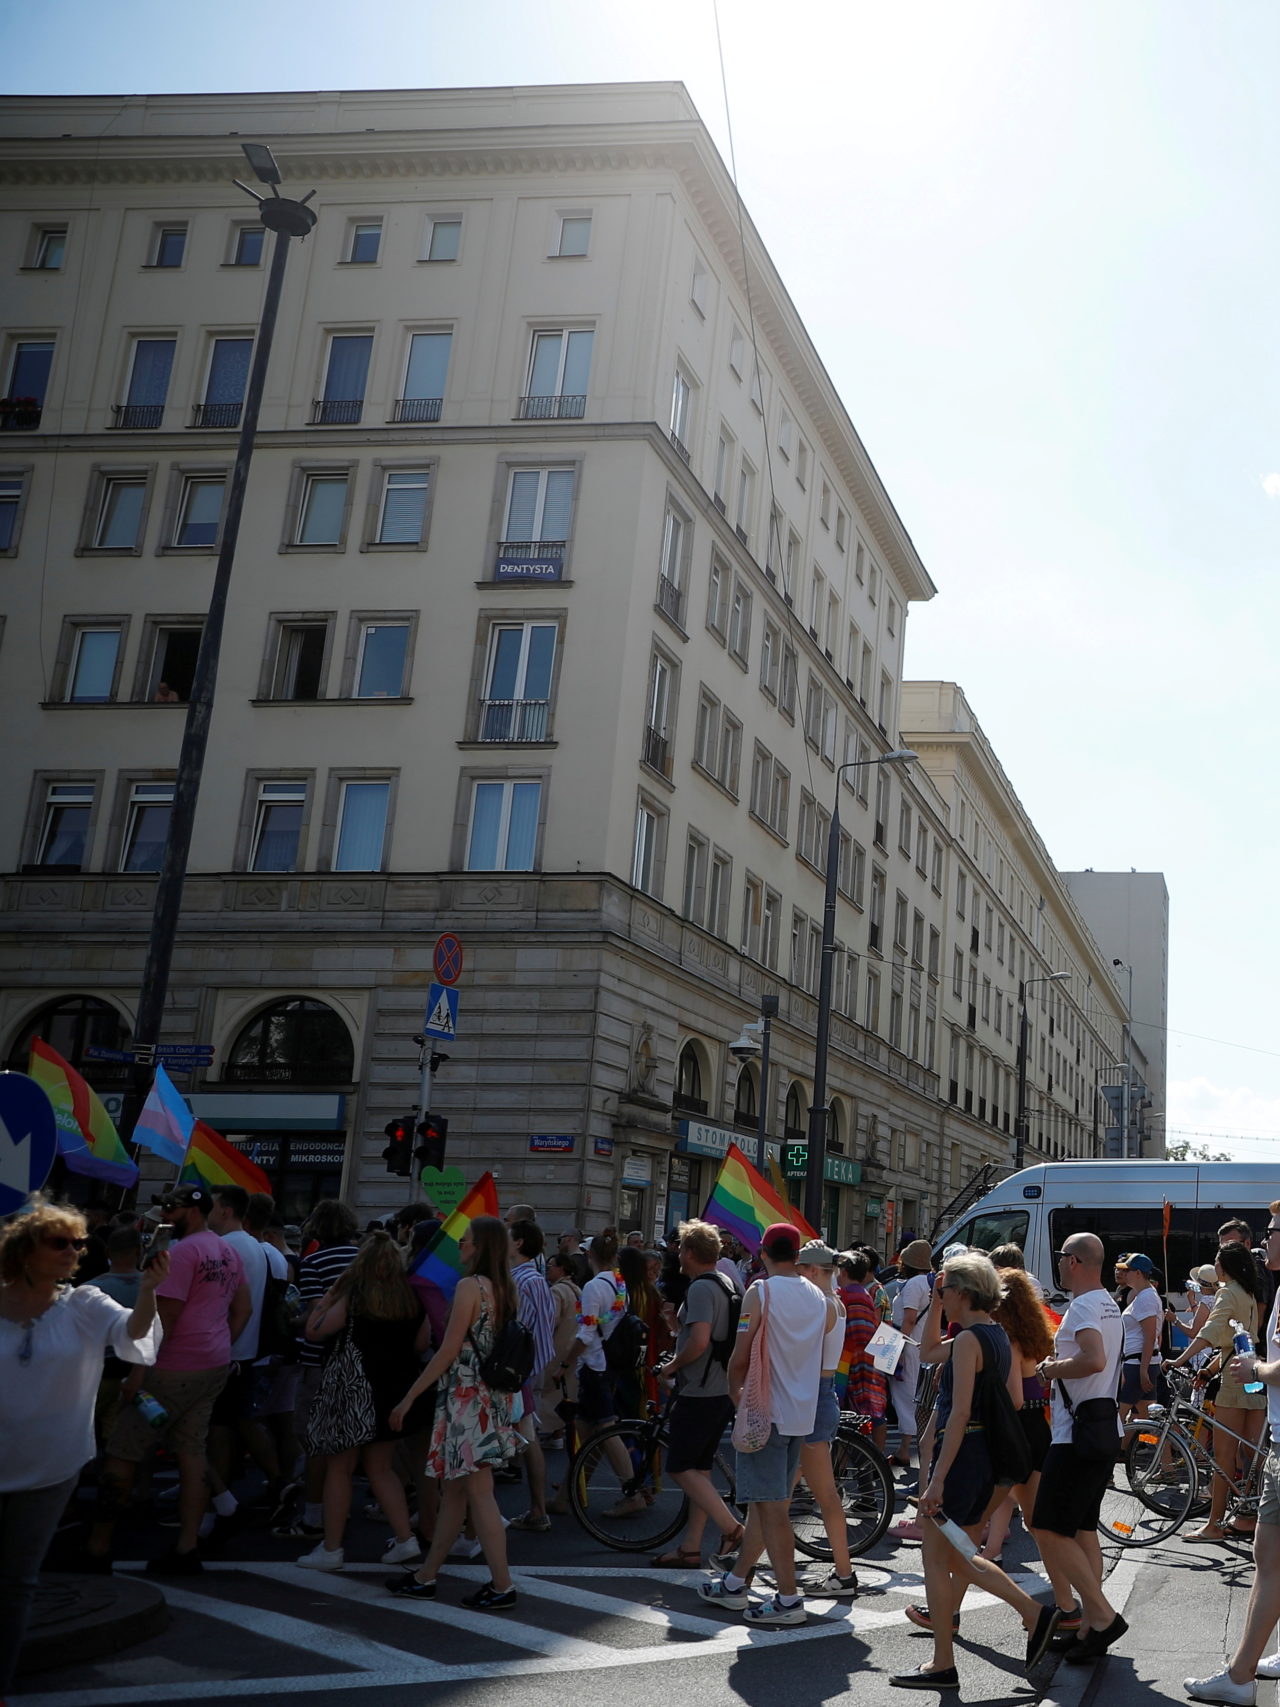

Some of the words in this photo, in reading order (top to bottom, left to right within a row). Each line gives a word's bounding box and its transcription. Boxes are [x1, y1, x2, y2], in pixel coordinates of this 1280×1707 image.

[500, 564, 555, 574] DENTYSTA
[56, 1111, 81, 1132] elon
[534, 1139, 570, 1148] Waryńskiego
[697, 1127, 774, 1156] STOMATOLOIA
[827, 1158, 853, 1182] TEKA
